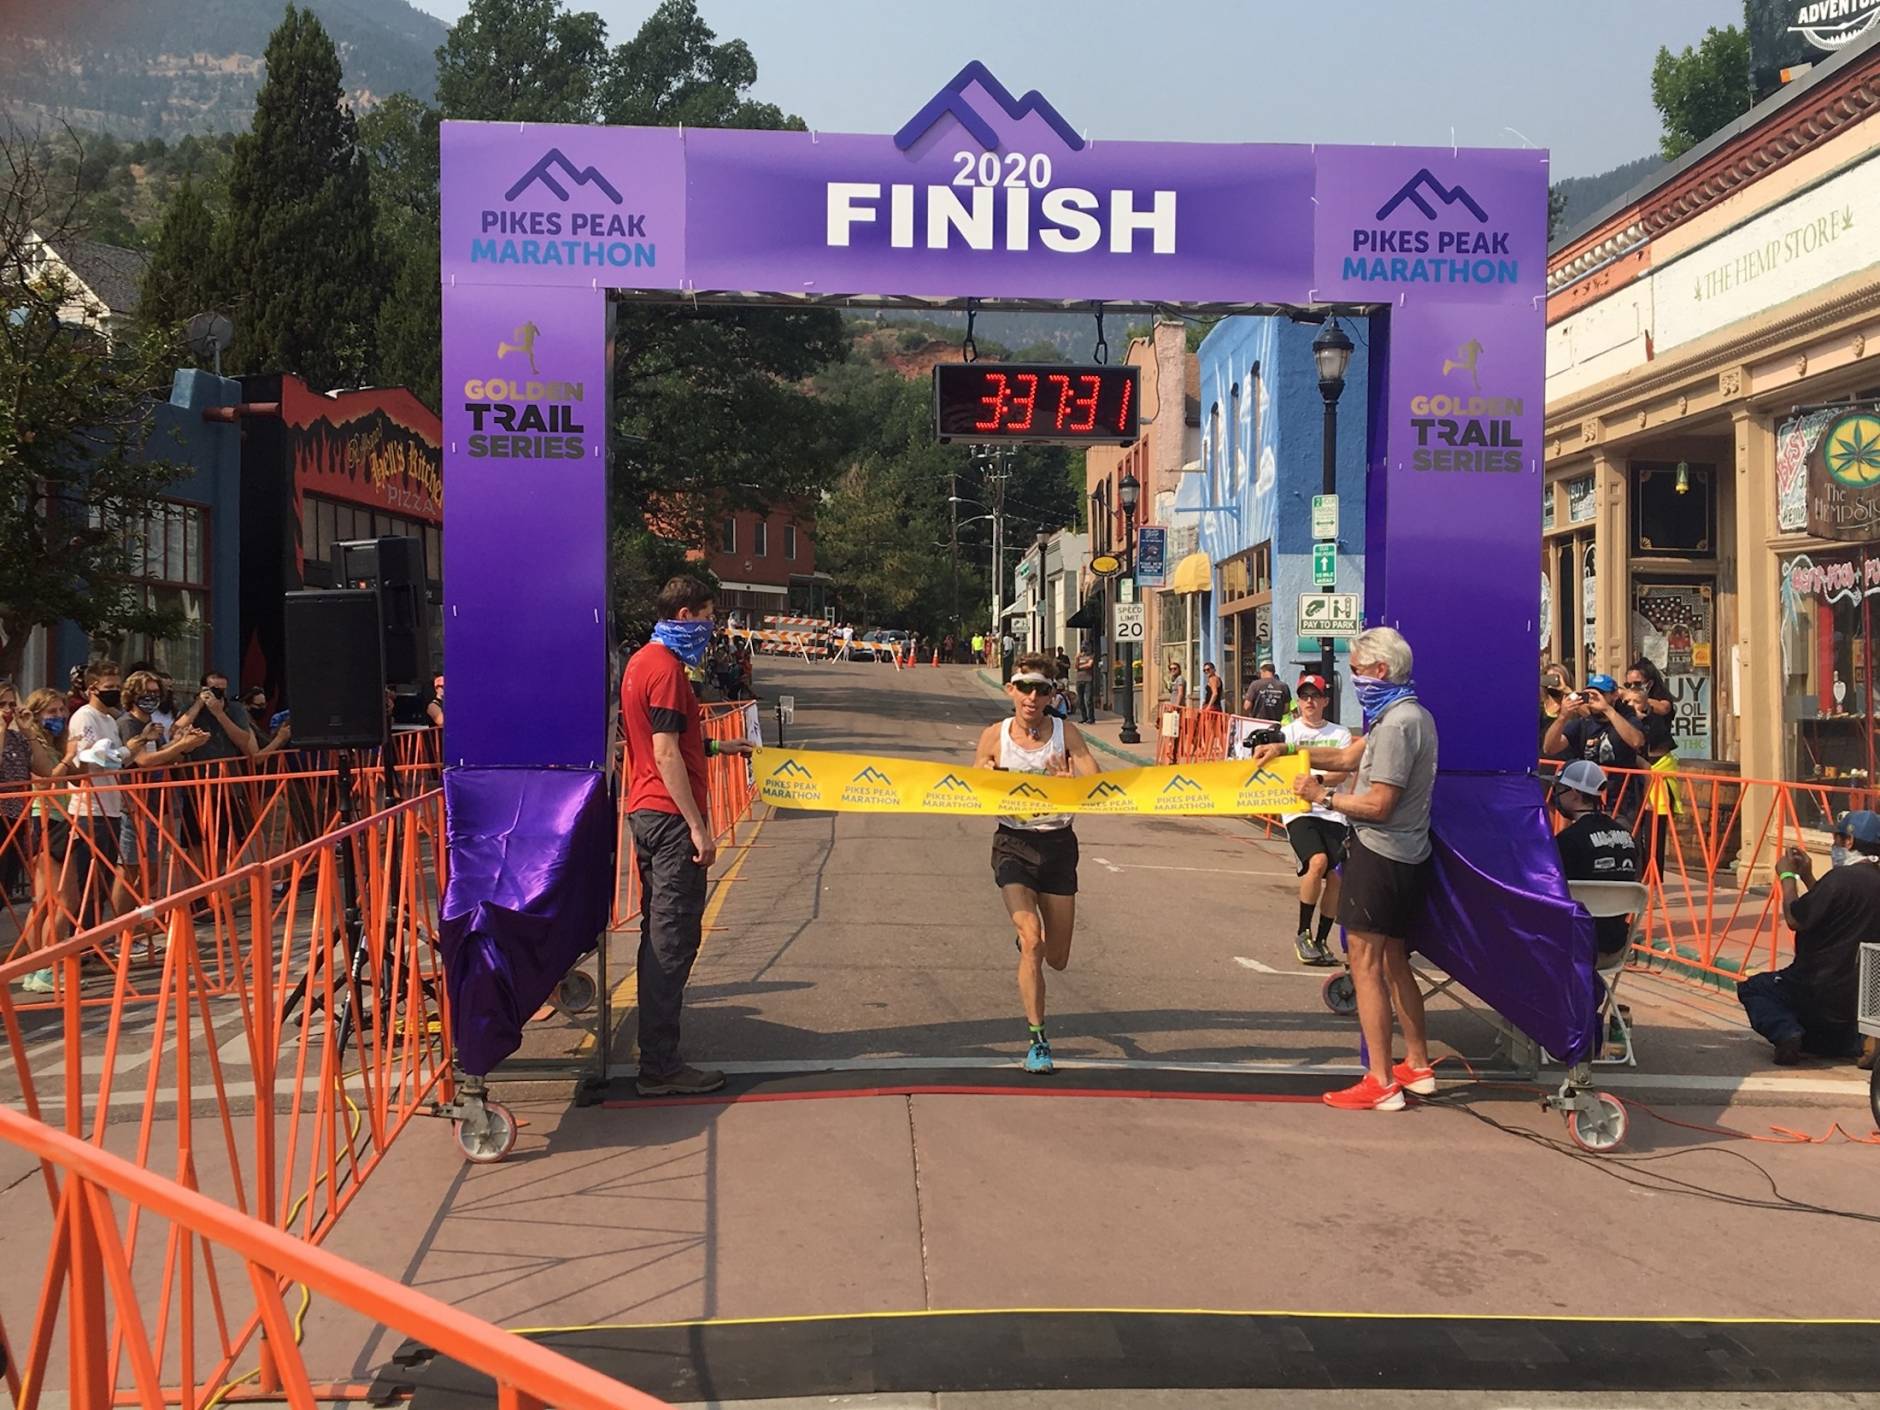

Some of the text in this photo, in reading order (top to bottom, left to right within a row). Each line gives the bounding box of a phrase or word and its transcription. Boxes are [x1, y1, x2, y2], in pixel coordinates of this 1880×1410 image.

[952, 151, 1051, 188] 2020
[481, 210, 646, 238] PIKES PEAK
[827, 182, 1176, 254] FINISH
[470, 238, 656, 268] MARATHON
[1352, 229, 1510, 255] PIKES PEAK
[1704, 209, 1840, 300] THE HEMP STORE
[1341, 257, 1518, 284] MARATHON
[464, 378, 584, 402] GOLDEN
[975, 373, 1132, 432] 3:37:31
[1410, 393, 1524, 417] GOLDEN
[465, 403, 584, 433] TRAIL
[1410, 419, 1523, 448] TRAIL
[467, 434, 585, 460] SERIES
[1412, 448, 1523, 474] SERIES
[407, 440, 443, 508] Kitche
[387, 484, 436, 515] PIZZA
[1825, 483, 1847, 503] The
[1117, 605, 1142, 614] SPEED
[1118, 622, 1143, 637] 20
[1303, 620, 1354, 629] PAY TO PARK
[1664, 677, 1705, 702] UY
[1681, 702, 1706, 716] OIL
[762, 788, 821, 800] MARATHON
[765, 779, 817, 791] PIKES PEAK
[845, 785, 897, 797] PIKES PEAK
[926, 792, 978, 802] PIKES PEAK
[1238, 787, 1292, 799] PIKES PEAK
[841, 794, 900, 806] MARATHON
[922, 799, 982, 809] MARATHON
[1154, 801, 1215, 811] MARATHON
[1157, 794, 1210, 804] PIKES PEAK
[1236, 797, 1297, 808] MARATHON
